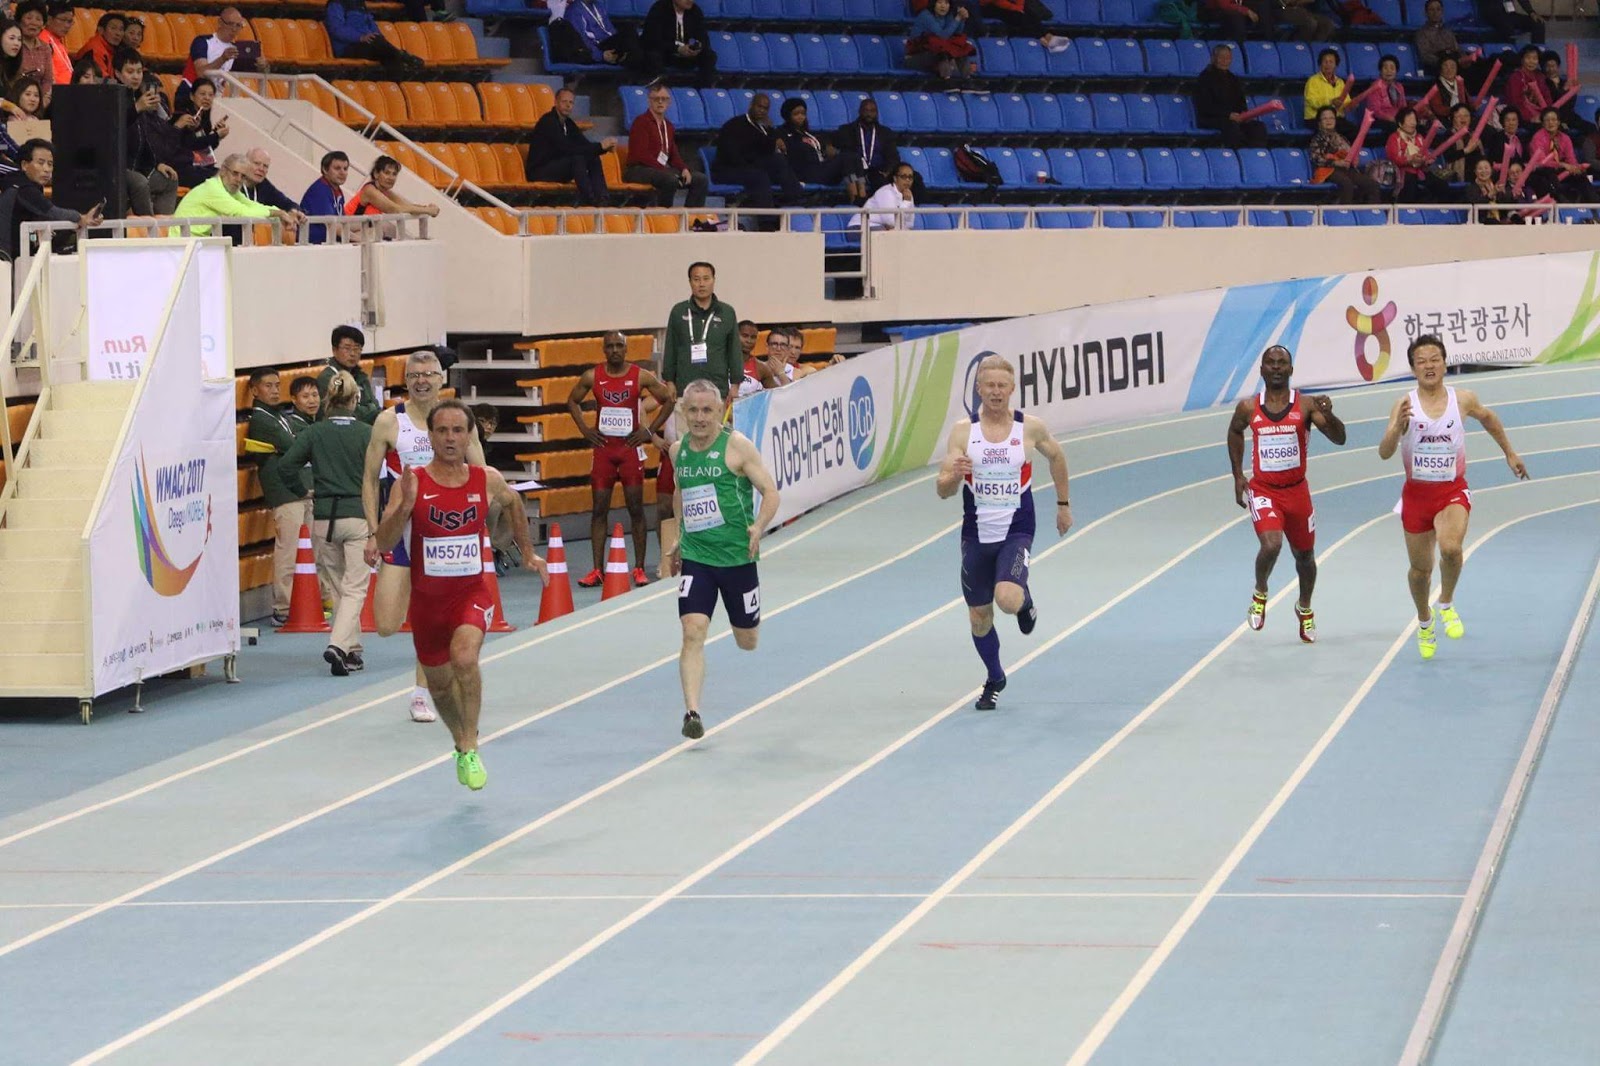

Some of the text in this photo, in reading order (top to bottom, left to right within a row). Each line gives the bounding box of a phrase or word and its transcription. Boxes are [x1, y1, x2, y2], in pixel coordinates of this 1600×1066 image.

[1475, 347, 1532, 362] ORGANIZATION
[1019, 331, 1165, 409] HYUNDAI
[602, 388, 631, 404] USA
[601, 417, 632, 427] M50013
[849, 396, 874, 440] DGB
[983, 448, 1009, 456] GREAT
[1261, 445, 1298, 459] M55688
[1414, 456, 1455, 468] M55547
[187, 459, 206, 495] 2017
[975, 482, 1019, 495] M55142
[429, 504, 478, 532] USA
[426, 543, 478, 559] M55740
